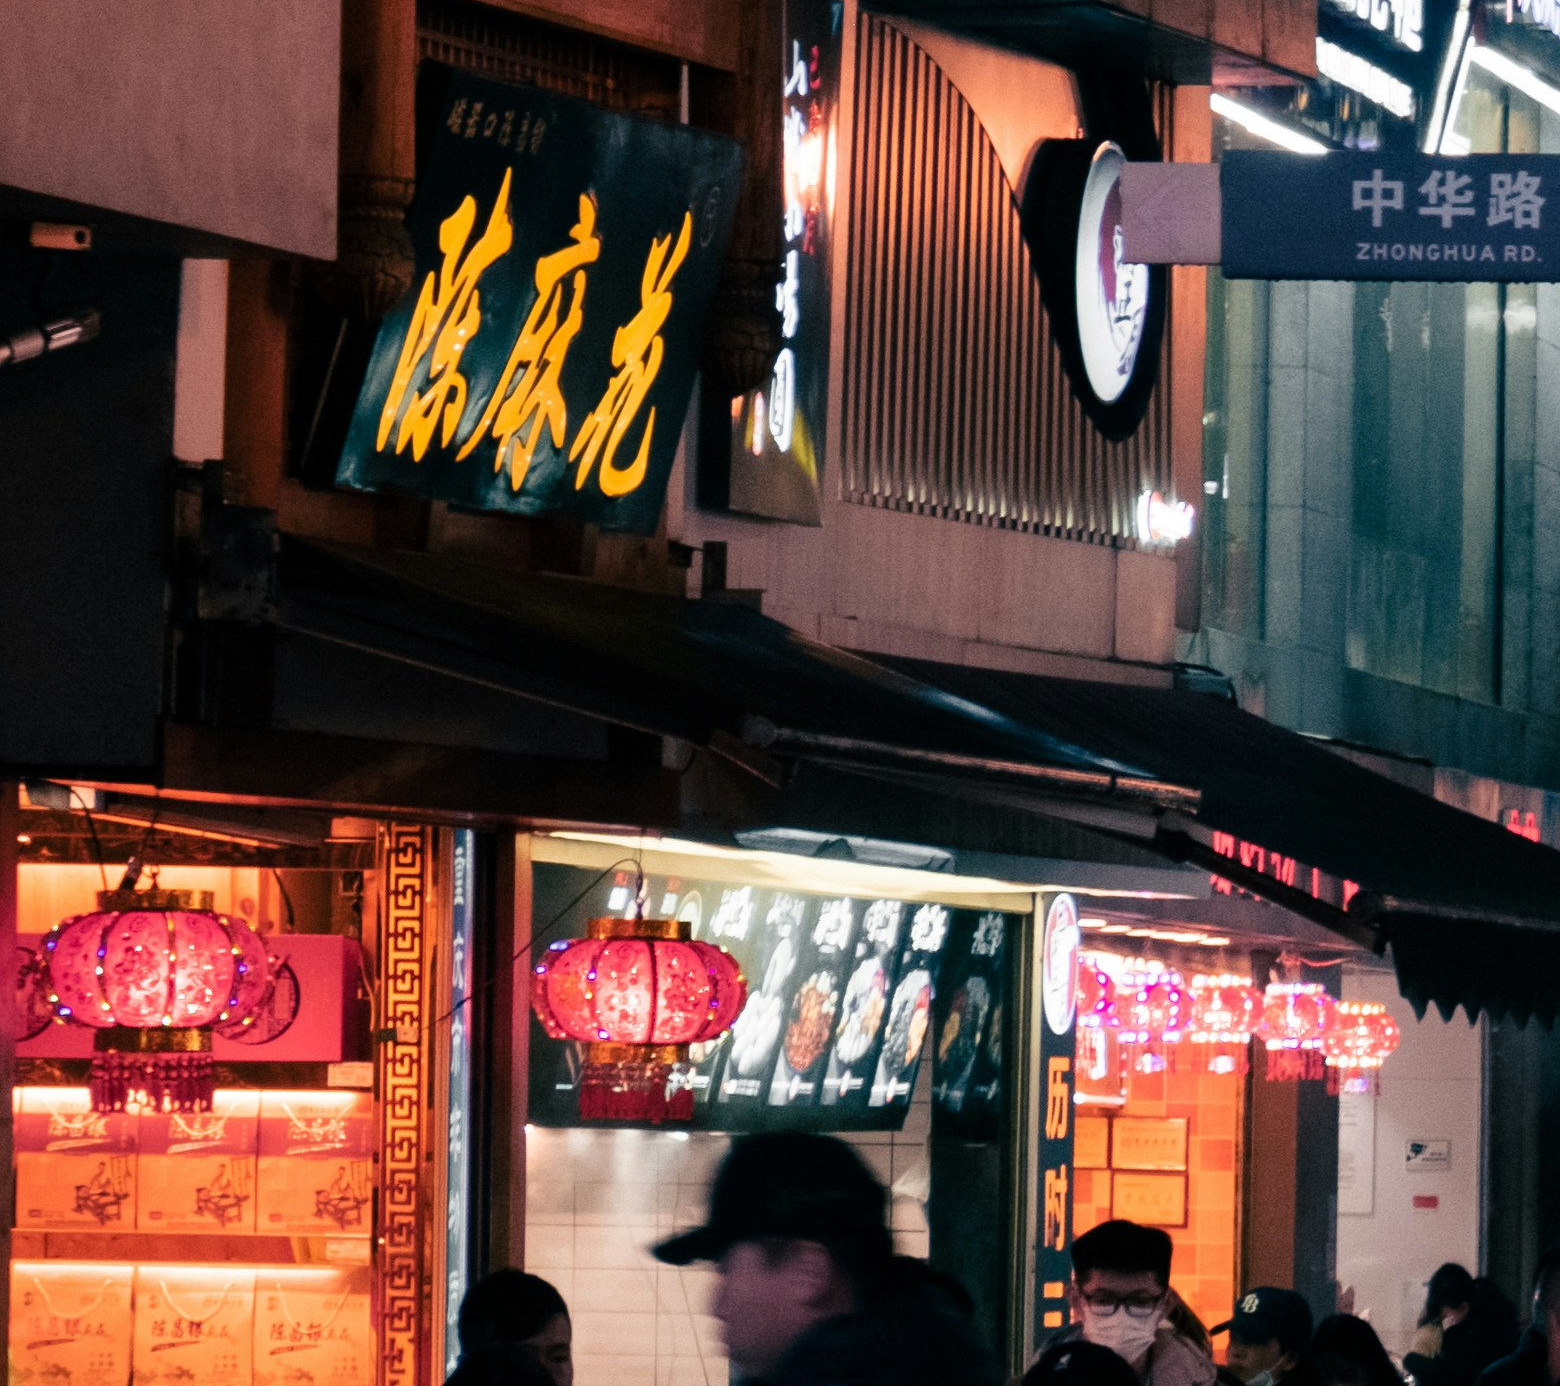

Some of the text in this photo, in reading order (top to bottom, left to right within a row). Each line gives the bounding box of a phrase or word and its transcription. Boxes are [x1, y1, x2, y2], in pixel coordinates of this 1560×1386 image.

[1352, 169, 1547, 229] 中华路
[1356, 243, 1543, 264] ZHONGHUA RD.
